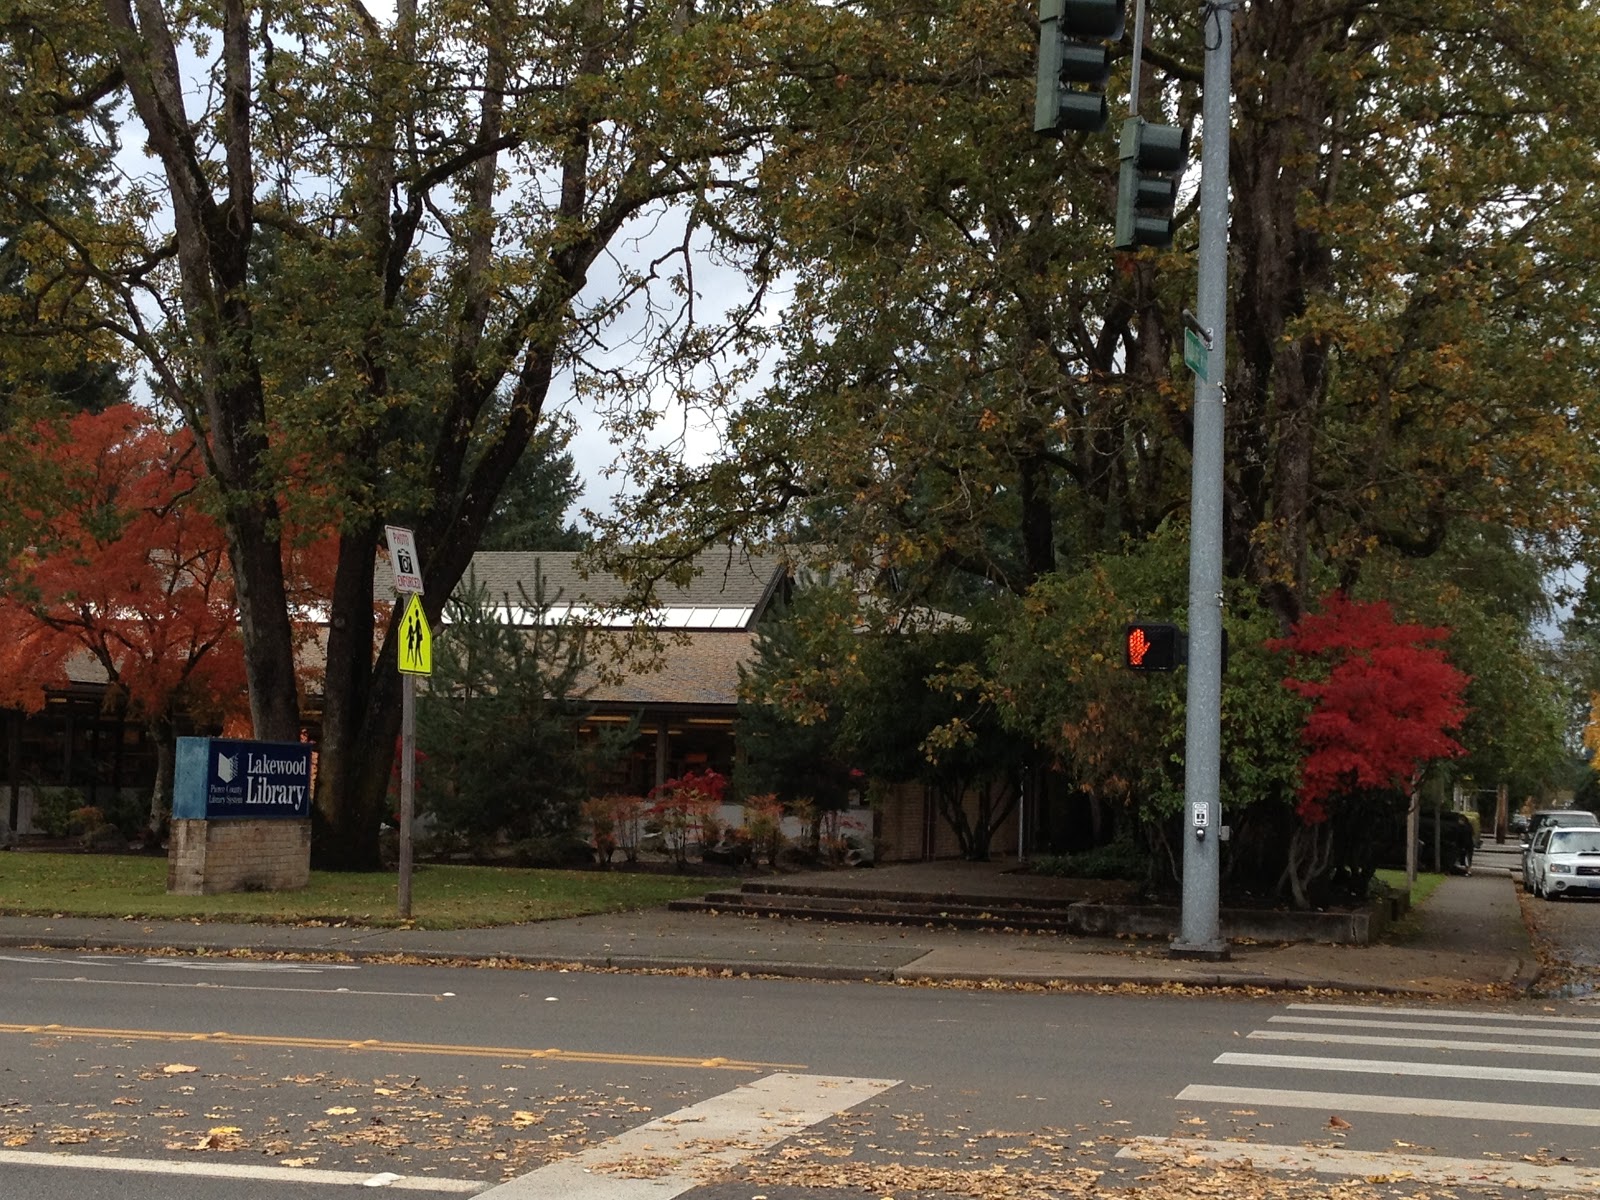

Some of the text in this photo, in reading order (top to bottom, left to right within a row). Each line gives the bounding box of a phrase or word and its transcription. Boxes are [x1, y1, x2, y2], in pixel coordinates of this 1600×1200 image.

[393, 532, 409, 545] PHOTO
[397, 574, 421, 589] ENFORCED
[247, 753, 306, 775] Lakewood
[210, 784, 242, 795] Pierce County
[246, 776, 305, 811] Library
[209, 795, 243, 805] Library System
